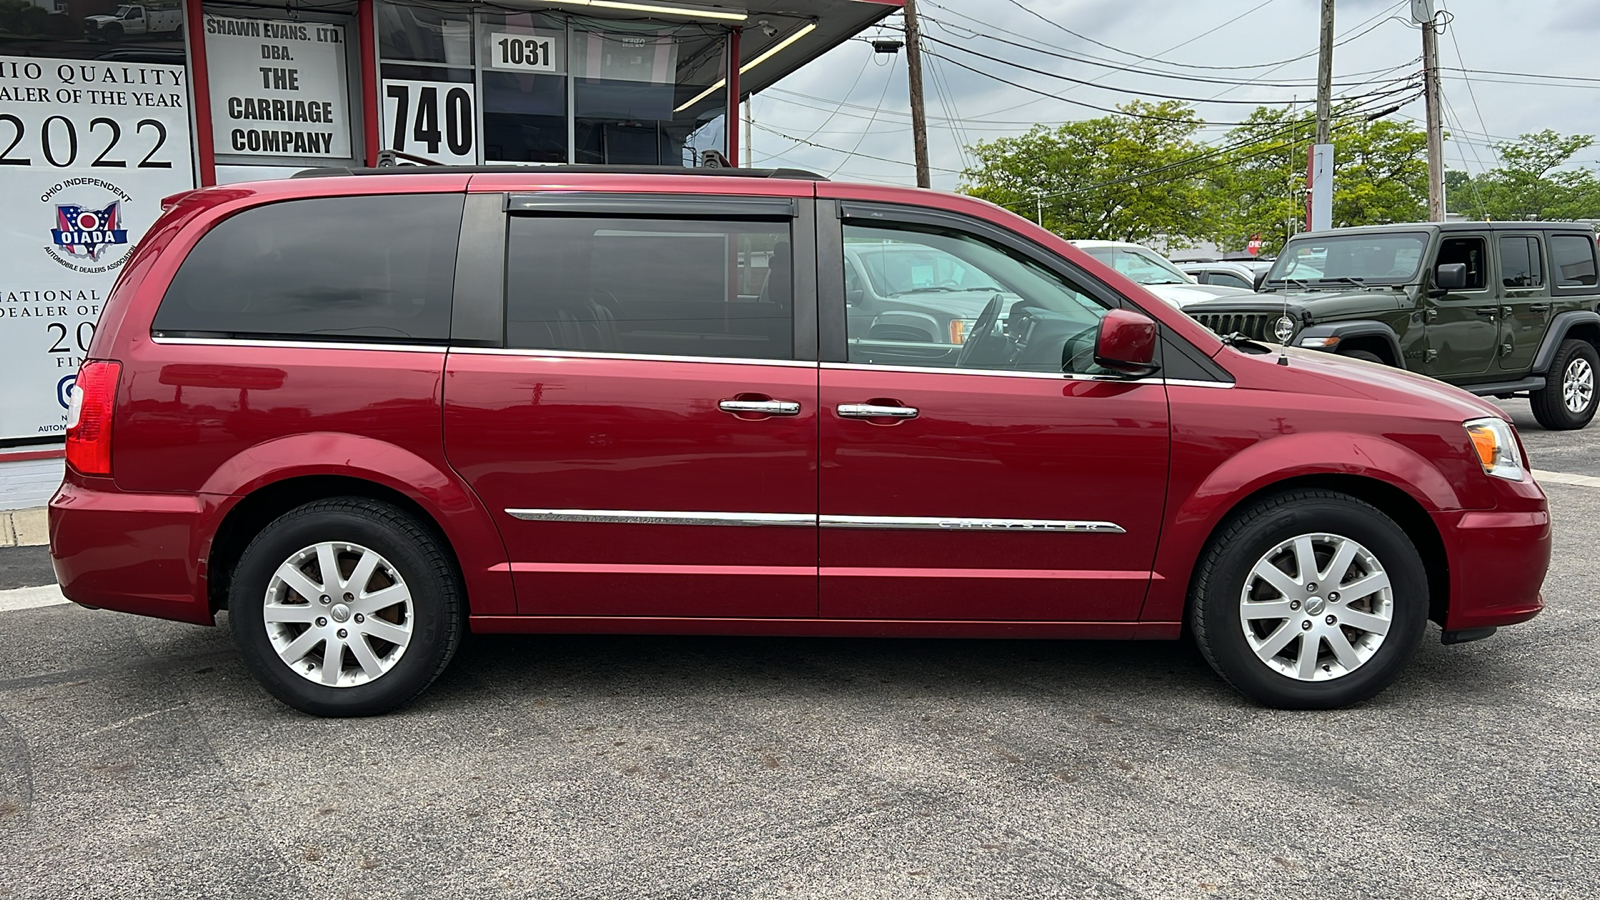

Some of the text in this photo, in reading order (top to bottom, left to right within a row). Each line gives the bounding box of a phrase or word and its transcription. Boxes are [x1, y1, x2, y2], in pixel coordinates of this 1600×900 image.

[206, 18, 260, 37] SHAWN
[316, 27, 343, 43] LTD.
[261, 44, 294, 61] DBA.
[498, 38, 549, 66] 1031
[0, 62, 183, 86] IO QUALITY
[259, 67, 299, 91] THE
[56, 88, 82, 104] OF
[87, 90, 128, 106] THE
[131, 92, 183, 108] YEAR
[228, 96, 333, 124] CARRIAGE
[386, 84, 473, 156] 740
[0, 113, 172, 169] 2022
[231, 128, 333, 154] COMPANY
[40, 177, 132, 203] OHIO INDEPENDENT
[61, 231, 115, 244] OIADA
[43, 246, 78, 272] AUTOMOBILE
[79, 265, 106, 273] DEALERS
[0, 289, 100, 302] ATIONAL
[76, 305, 99, 316] OF
[938, 520, 1098, 530] CHRYSLER
